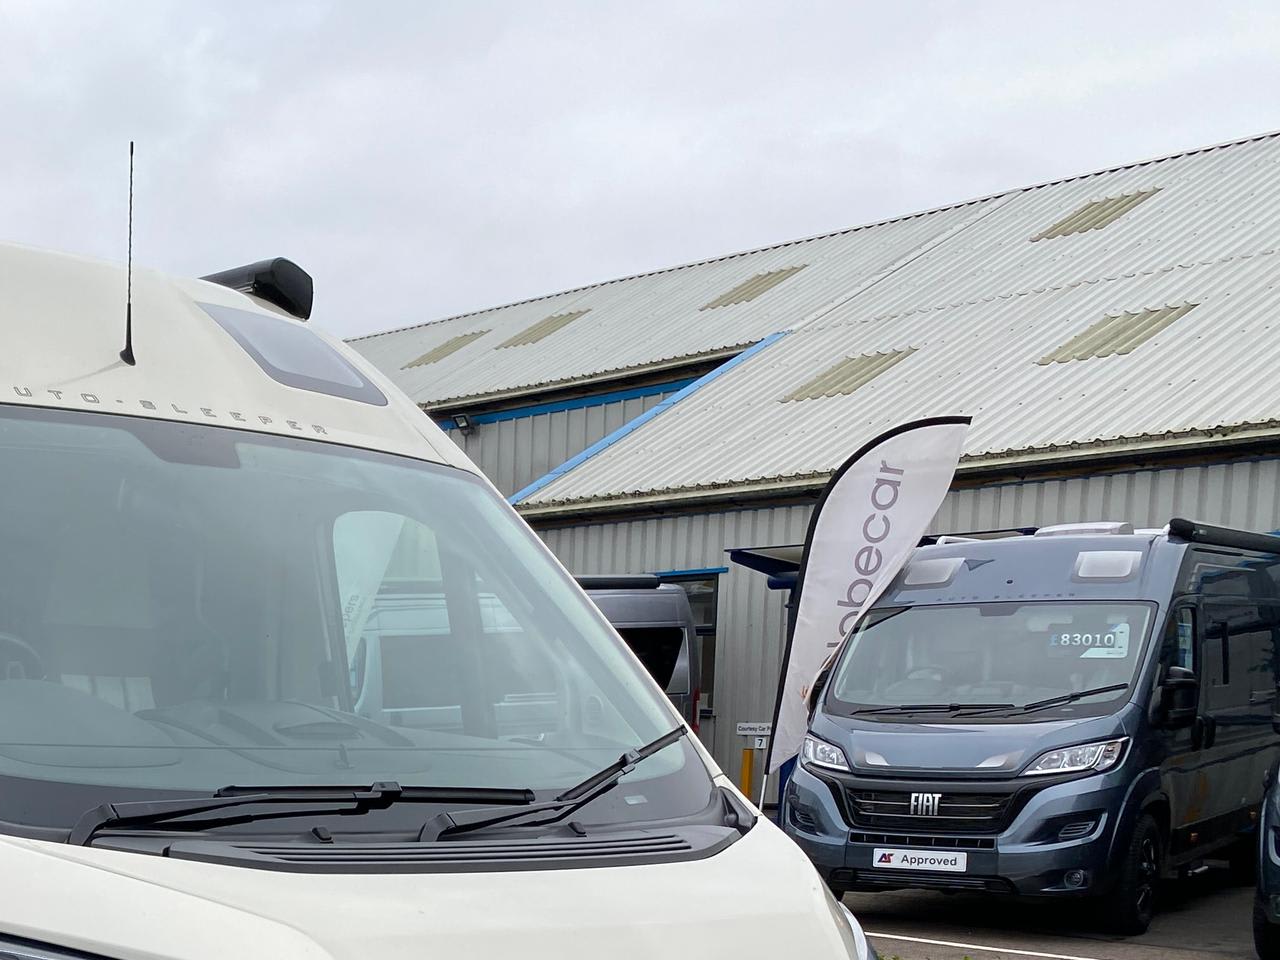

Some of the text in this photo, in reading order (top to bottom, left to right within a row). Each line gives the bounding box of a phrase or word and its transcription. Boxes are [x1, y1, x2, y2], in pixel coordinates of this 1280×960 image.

[758, 739, 763, 747] 7
[910, 793, 942, 815] FIAT
[901, 854, 958, 866] Approved
